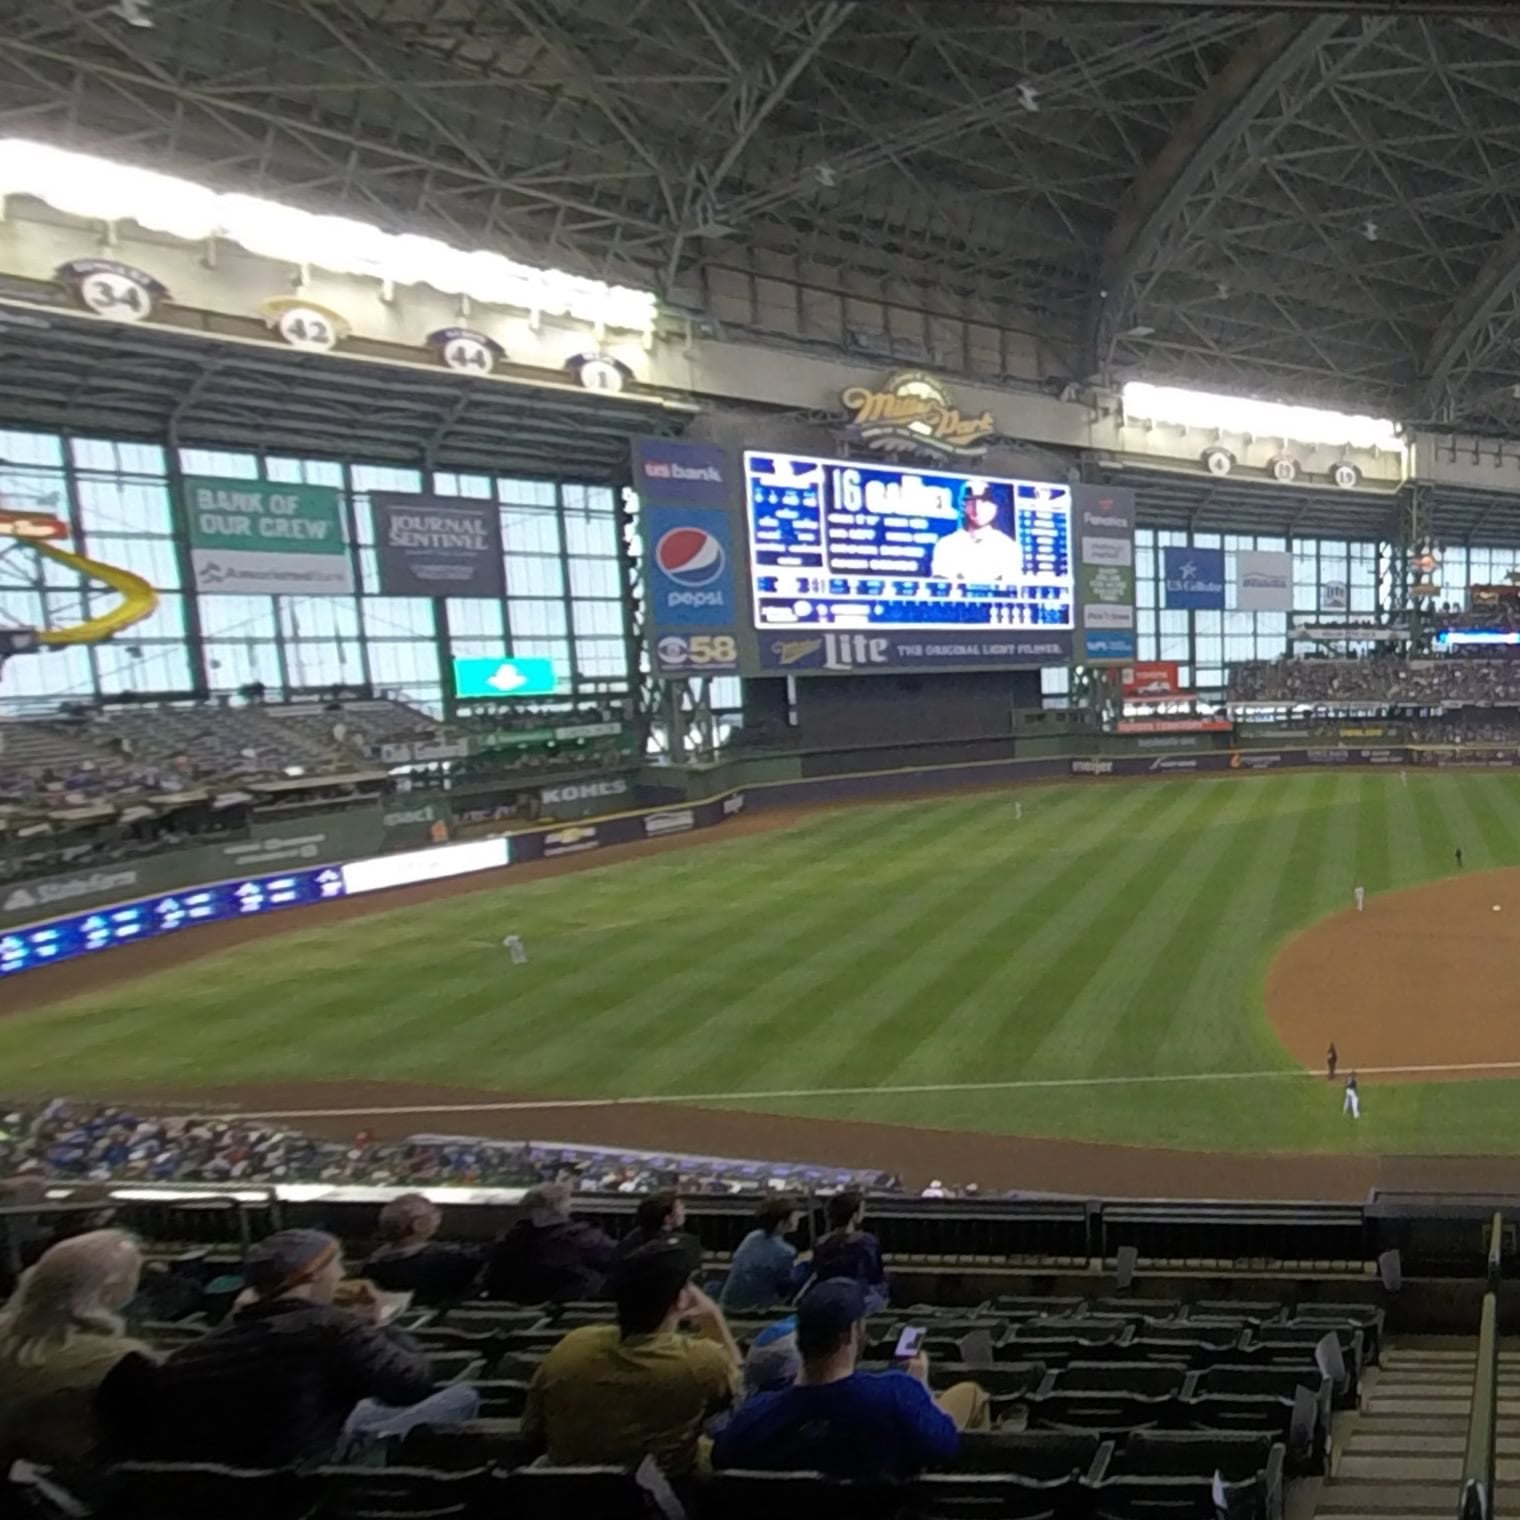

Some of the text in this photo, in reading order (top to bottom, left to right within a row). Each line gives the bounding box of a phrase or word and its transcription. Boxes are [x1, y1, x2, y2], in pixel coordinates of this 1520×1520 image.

[92, 281, 142, 312] 34
[288, 317, 330, 344] 42
[452, 345, 487, 369] 44
[197, 488, 299, 515] BANK OF
[831, 468, 862, 512] 16
[201, 513, 328, 540] OUR CREW
[390, 515, 488, 536] JOURNAL
[389, 530, 489, 551] SENTINEL
[667, 591, 724, 608] pepsi
[689, 635, 737, 663] 58
[822, 633, 889, 671] Lite
[896, 644, 922, 656] THE
